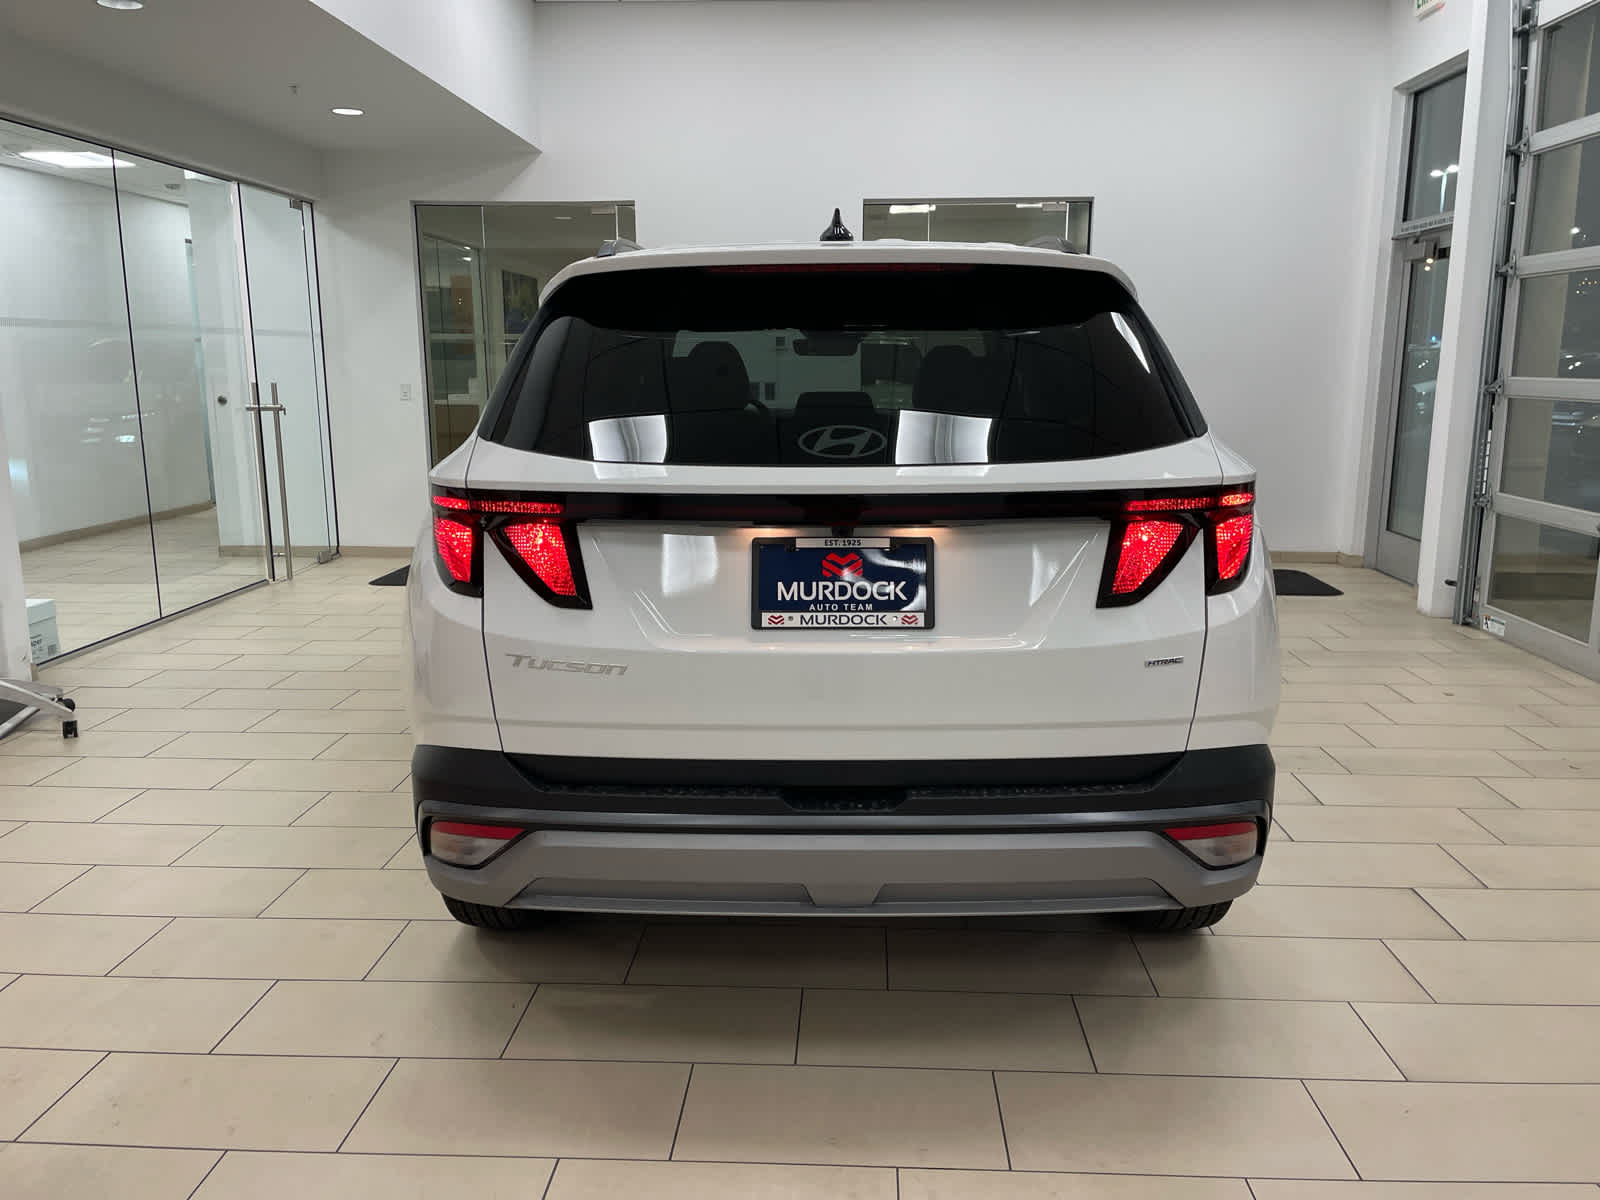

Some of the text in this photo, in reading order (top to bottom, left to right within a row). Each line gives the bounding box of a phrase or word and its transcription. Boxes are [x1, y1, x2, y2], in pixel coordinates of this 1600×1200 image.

[824, 539, 862, 547] EST. 1925
[777, 581, 907, 601] MURDOCK
[808, 603, 873, 611] AUTO TEAM
[800, 614, 887, 625] MURDOCK
